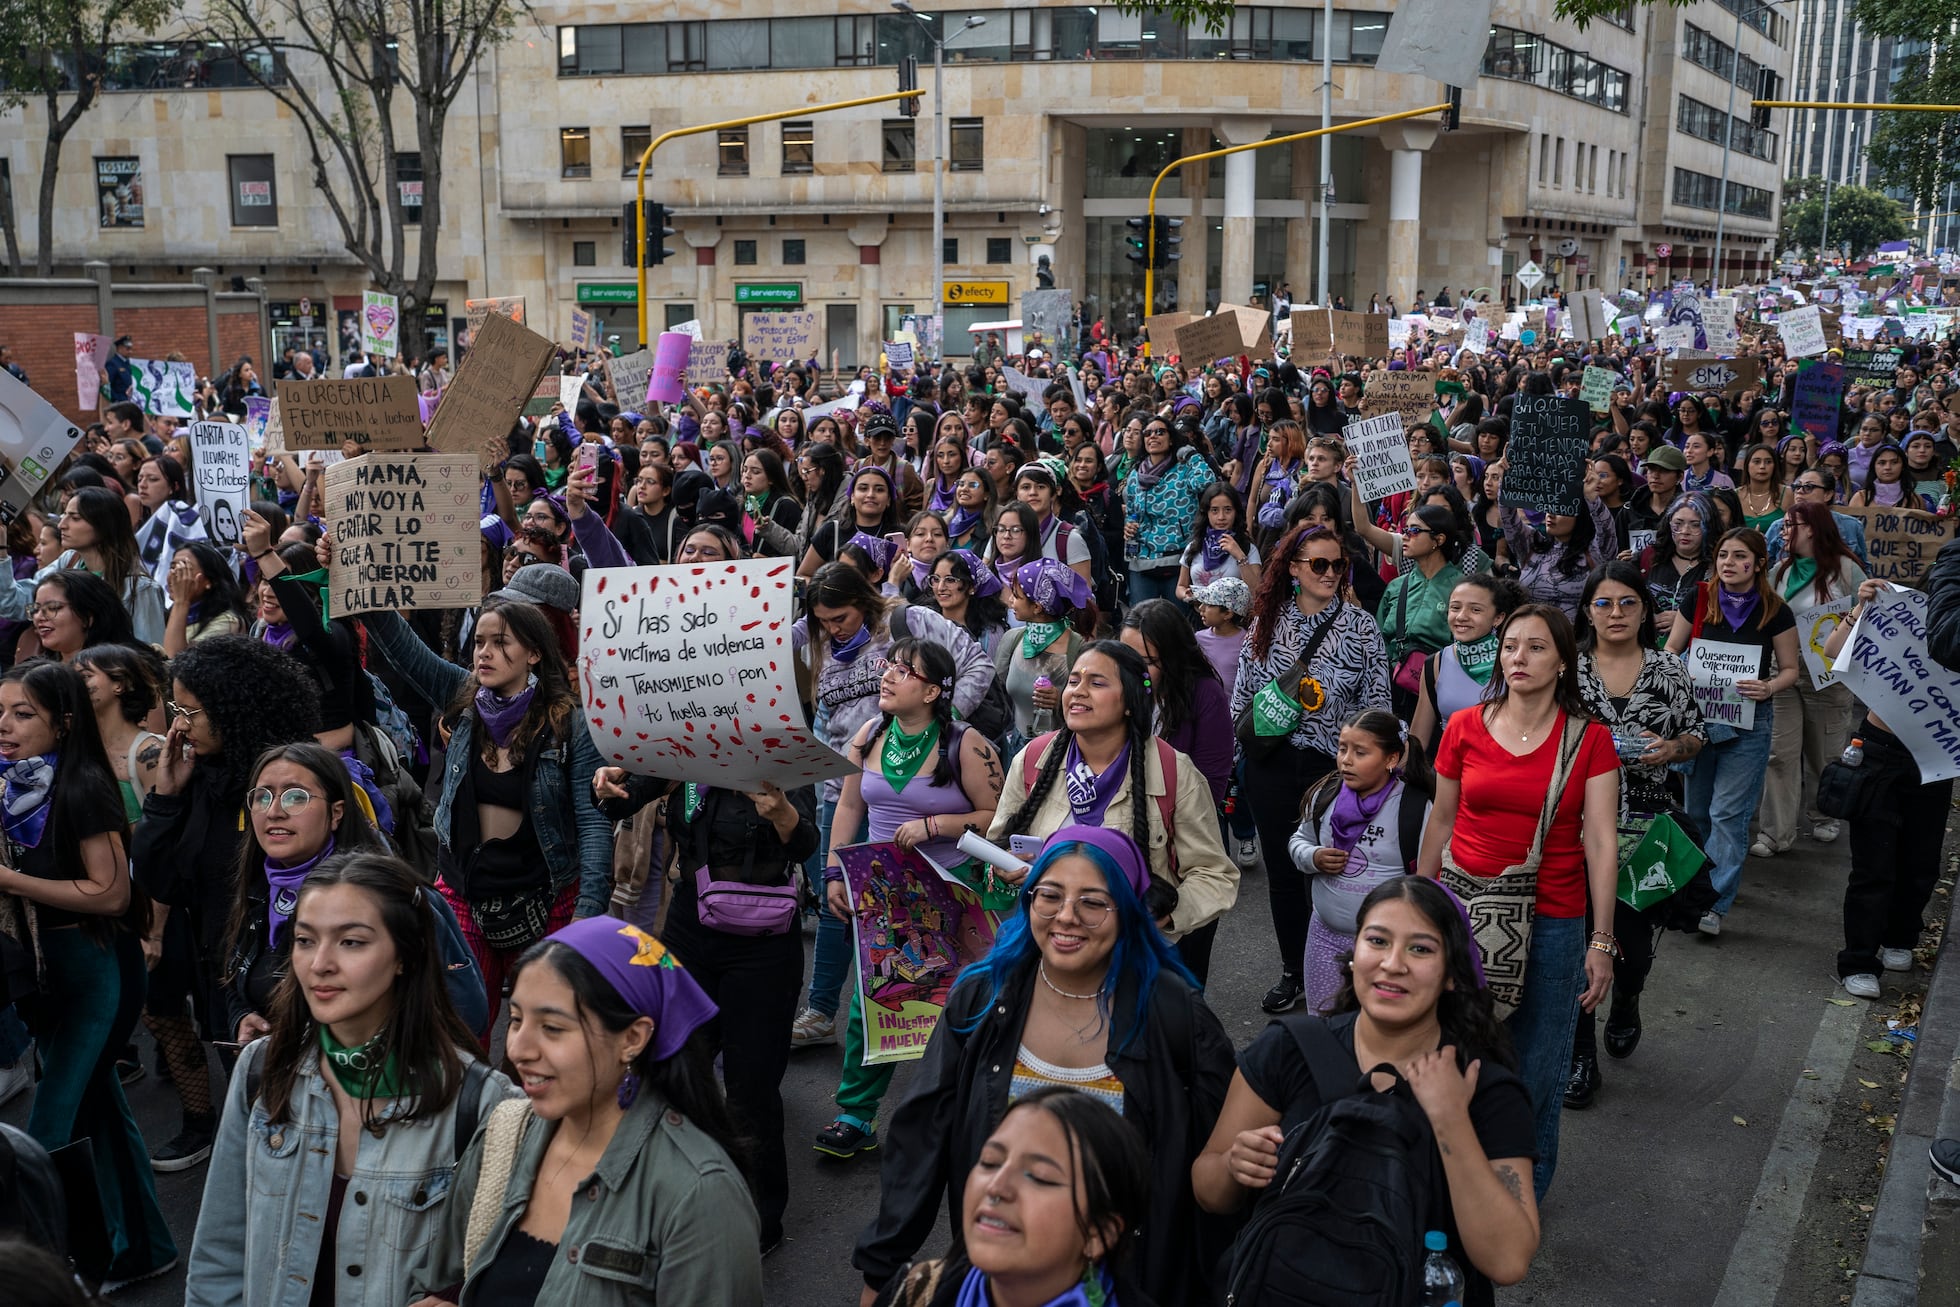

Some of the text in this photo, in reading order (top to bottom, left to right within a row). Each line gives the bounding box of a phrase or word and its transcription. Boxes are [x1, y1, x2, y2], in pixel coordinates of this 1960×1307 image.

[592, 289, 636, 299] servientrega
[751, 288, 796, 299] servientrega
[964, 287, 995, 298] efecty
[1341, 314, 1383, 338] Amiga
[748, 336, 764, 346] HOY
[772, 336, 782, 345] NO
[1379, 372, 1389, 381] LA
[1391, 371, 1429, 382] PROXIMA
[1696, 366, 1722, 384] 8M
[308, 382, 393, 406] URGENCIA
[1382, 383, 1411, 392] SOY YO
[1533, 398, 1567, 413] QUE
[287, 407, 417, 428] FEMENINA de luchar
[1343, 424, 1359, 442] NI
[1373, 412, 1402, 435] TIERRA
[1511, 419, 1544, 437] DE TU
[1539, 412, 1579, 434] MUJER
[194, 425, 244, 448] HARTA DE
[294, 430, 372, 446] Por MI VIDA
[1348, 432, 1407, 457] NI LAS MUJERES
[1510, 435, 1538, 450] VIDA
[202, 451, 242, 468] LLEVARME
[1360, 450, 1393, 470] SOMOS
[1507, 447, 1578, 469] QUE MATAR
[199, 468, 249, 488] LAS Pirobas
[356, 457, 427, 489] MAMÁ,
[1355, 461, 1409, 484] TERRITORIO
[1532, 466, 1559, 480] QUE
[1560, 468, 1576, 482] TE
[1363, 478, 1413, 502] CONQUISTA
[1364, 480, 1378, 492] DE
[1503, 476, 1568, 496] PREOCUPE LA
[346, 490, 426, 513] HOY VOY A
[1502, 489, 1561, 505] VIOLENCIA DE
[337, 513, 422, 543] GRITAR LO
[1875, 513, 1900, 533] POR
[1903, 515, 1946, 537] TODAS
[341, 545, 361, 567] QUE
[364, 542, 375, 563] A
[407, 541, 441, 563] TE
[1870, 538, 1922, 559] QUE SI
[359, 563, 438, 585] HICIERON
[345, 585, 417, 612] CALLAR
[602, 598, 719, 639] Si has sido
[1802, 611, 1821, 625] Yes
[619, 634, 766, 663] victima de violencia
[1460, 650, 1497, 666] LIBRE
[1702, 660, 1756, 674] enterrarnos
[600, 674, 619, 689] en
[738, 667, 768, 687] pon
[1709, 674, 1732, 687] Pero
[1694, 686, 1724, 701] SOMOS
[644, 701, 740, 724] tú huella aquí
[1257, 699, 1291, 729] LIBRE
[1261, 688, 1301, 722] ABORTO
[1703, 701, 1743, 724] SEMILLA
[1325, 878, 1376, 894] AWESOM
[880, 1031, 928, 1052] MUEVE
